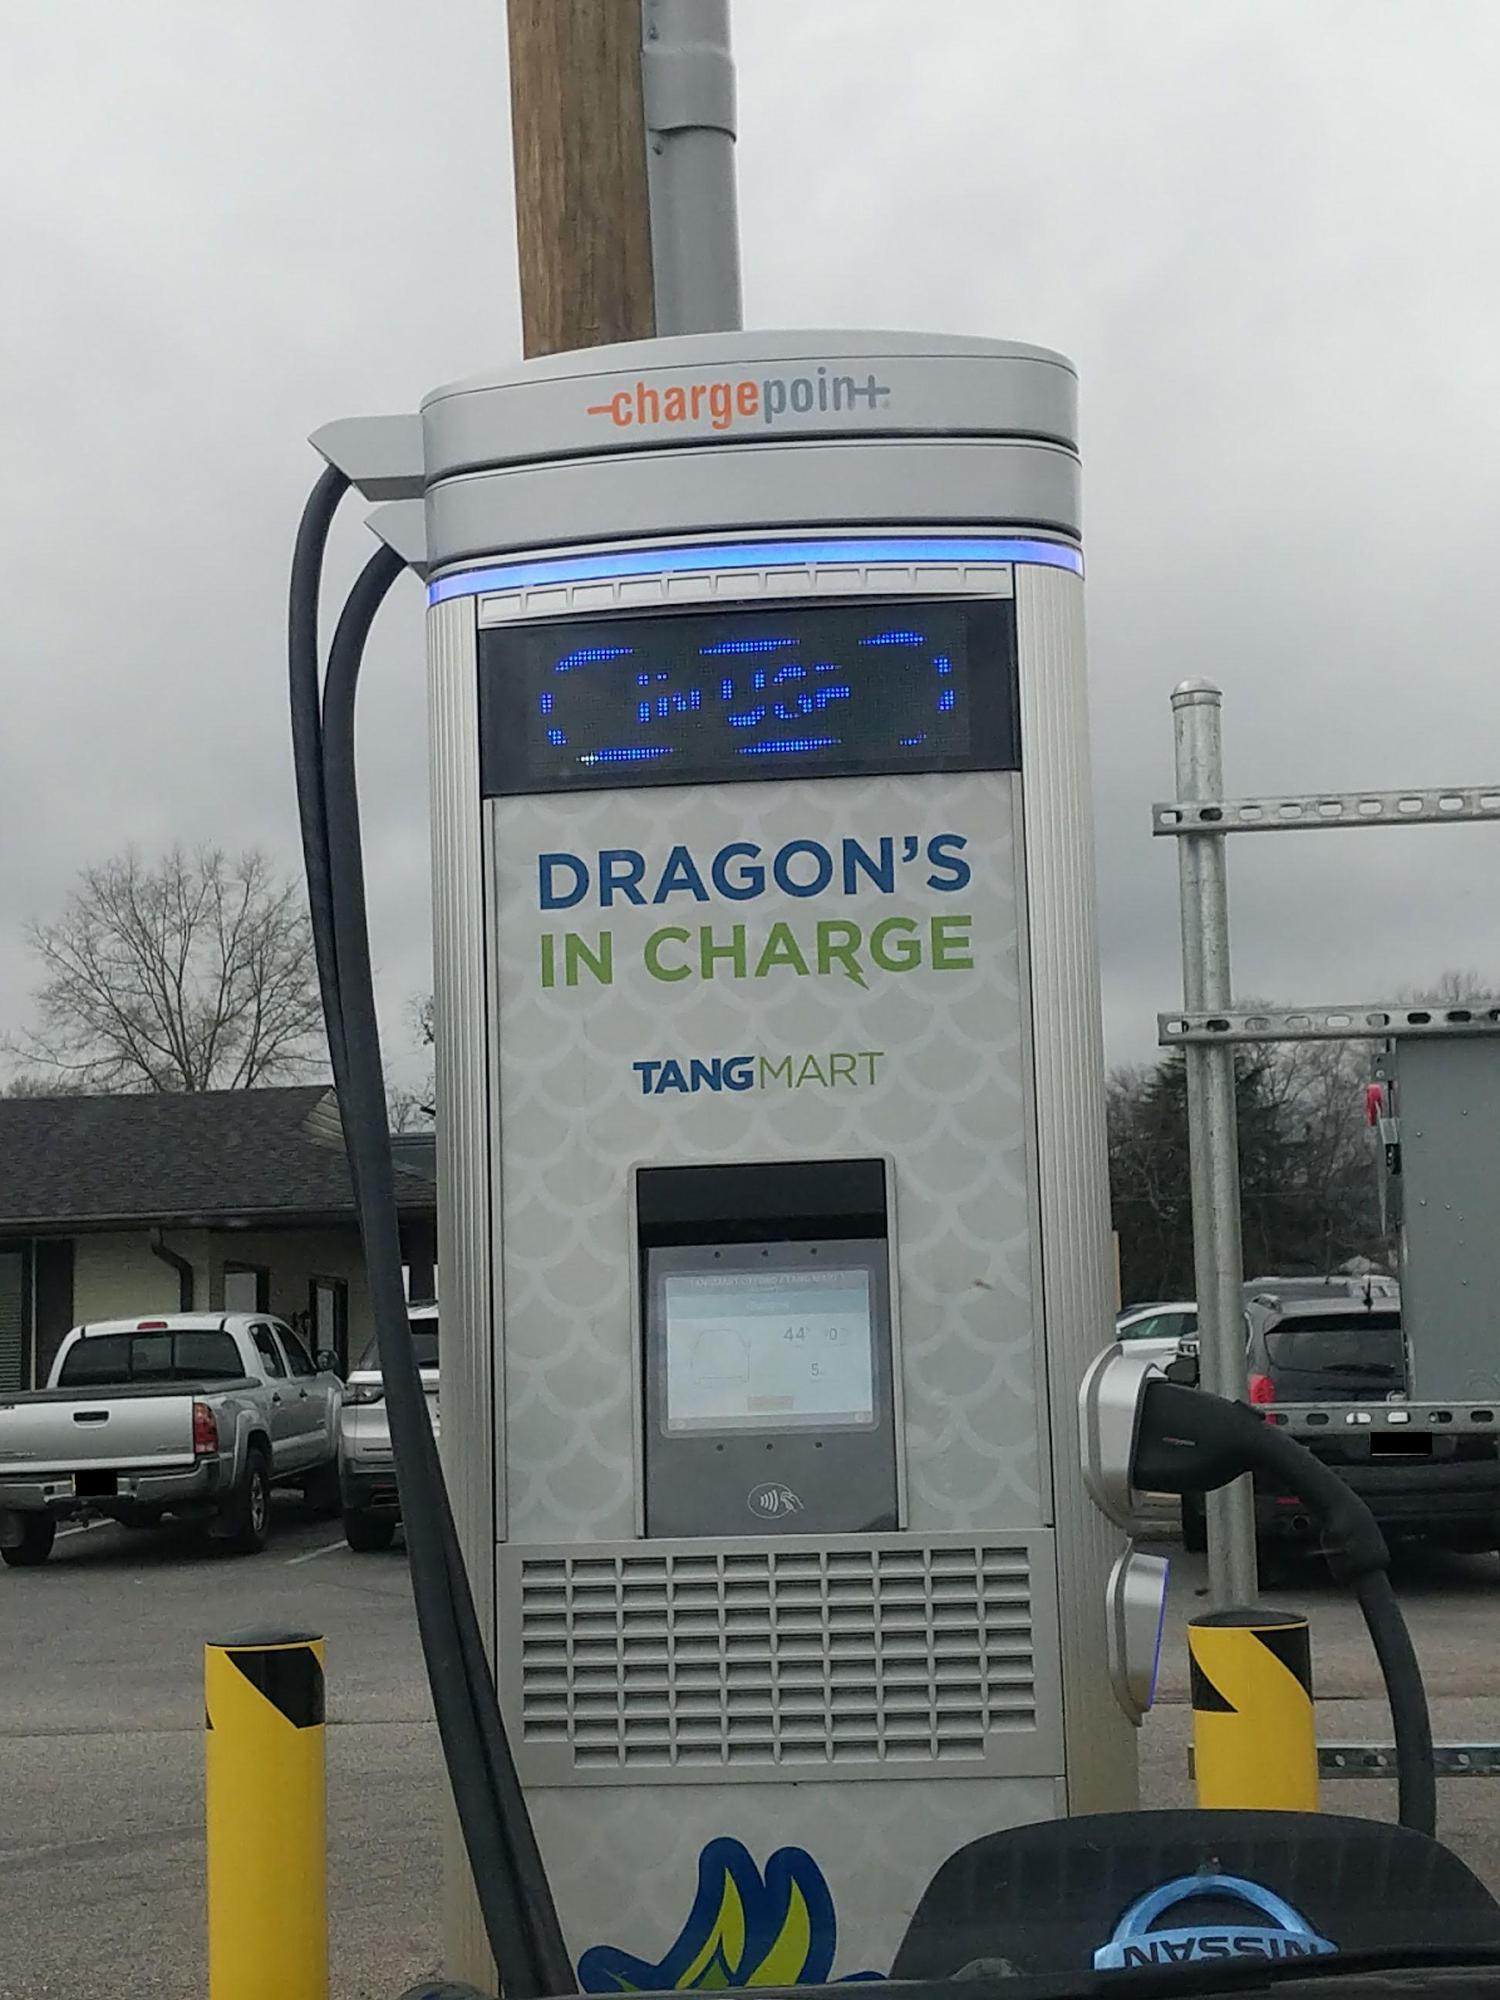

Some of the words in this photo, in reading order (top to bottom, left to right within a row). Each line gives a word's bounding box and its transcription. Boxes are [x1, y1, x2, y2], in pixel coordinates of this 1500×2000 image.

[538, 834, 971, 910] DRAGON'S
[541, 931, 613, 988] IN
[643, 915, 975, 991] CHARGE
[633, 1052, 884, 1094] TANGMART
